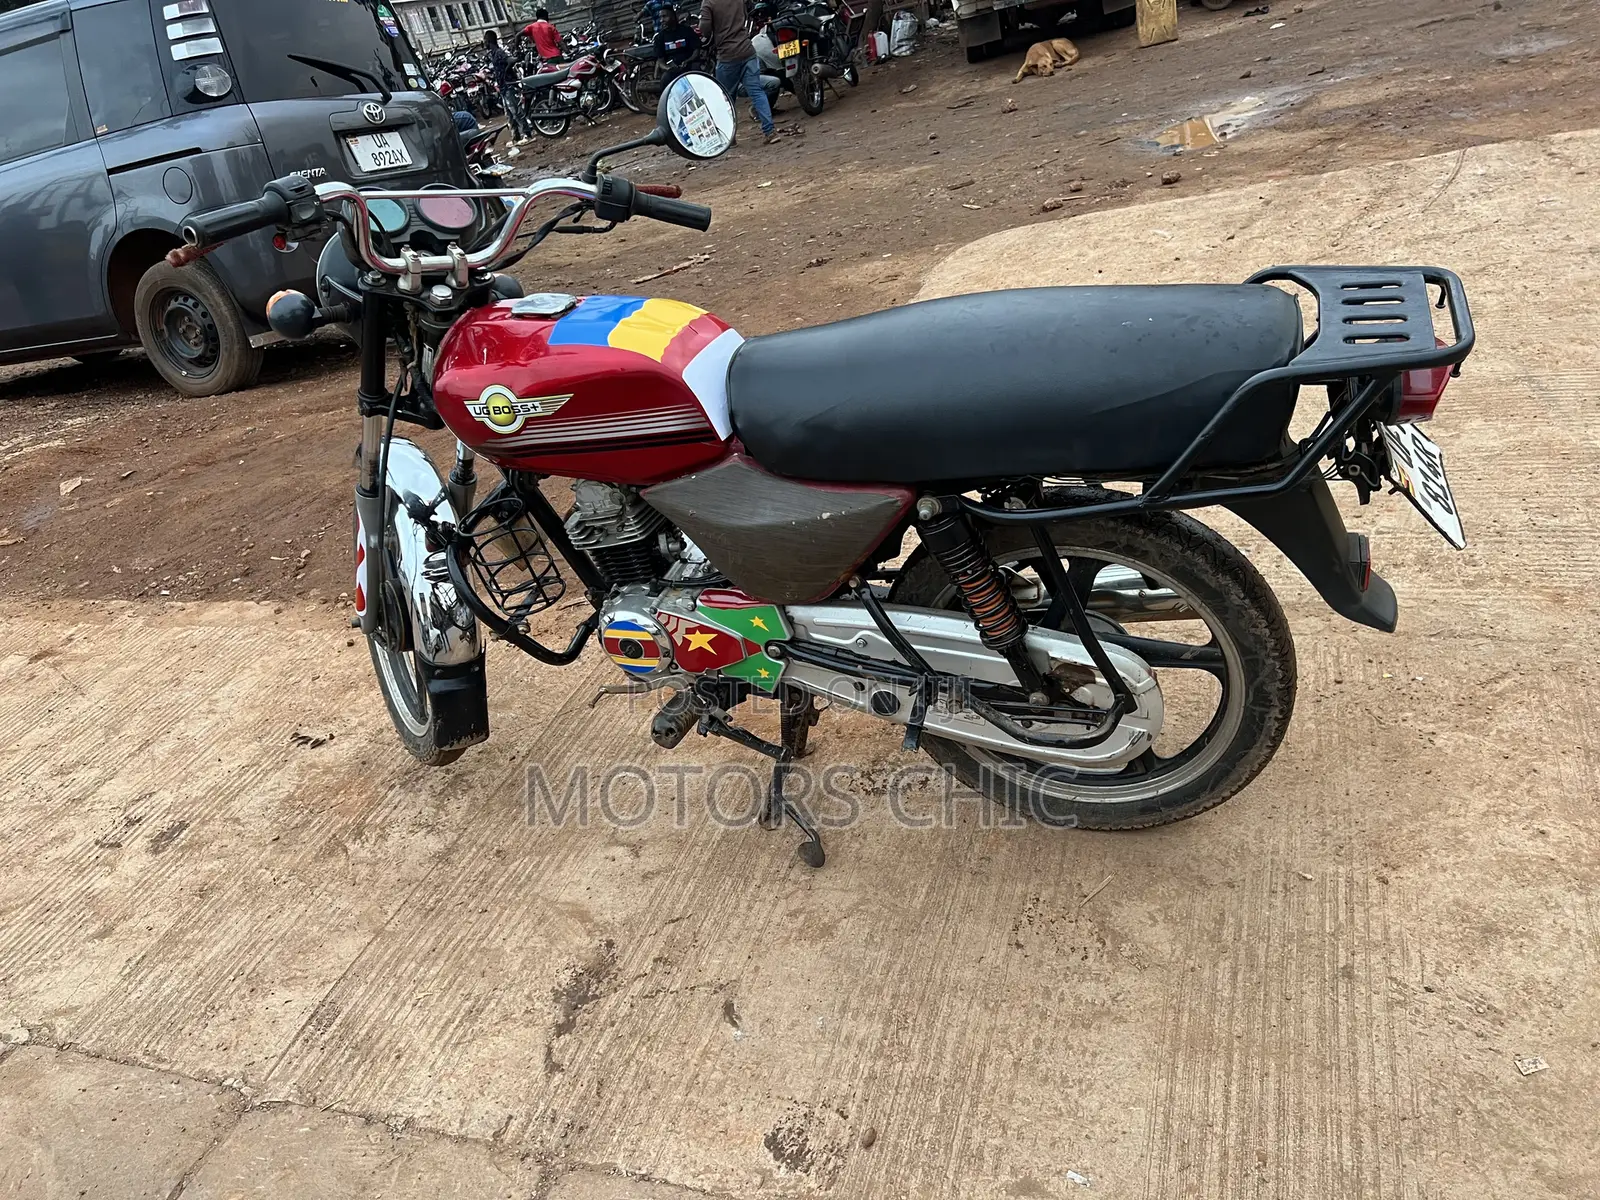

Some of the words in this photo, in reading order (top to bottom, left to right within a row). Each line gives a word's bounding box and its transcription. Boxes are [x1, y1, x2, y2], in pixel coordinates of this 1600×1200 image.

[370, 133, 391, 148] UA
[371, 149, 408, 167] 892AX
[473, 406, 491, 416] UG
